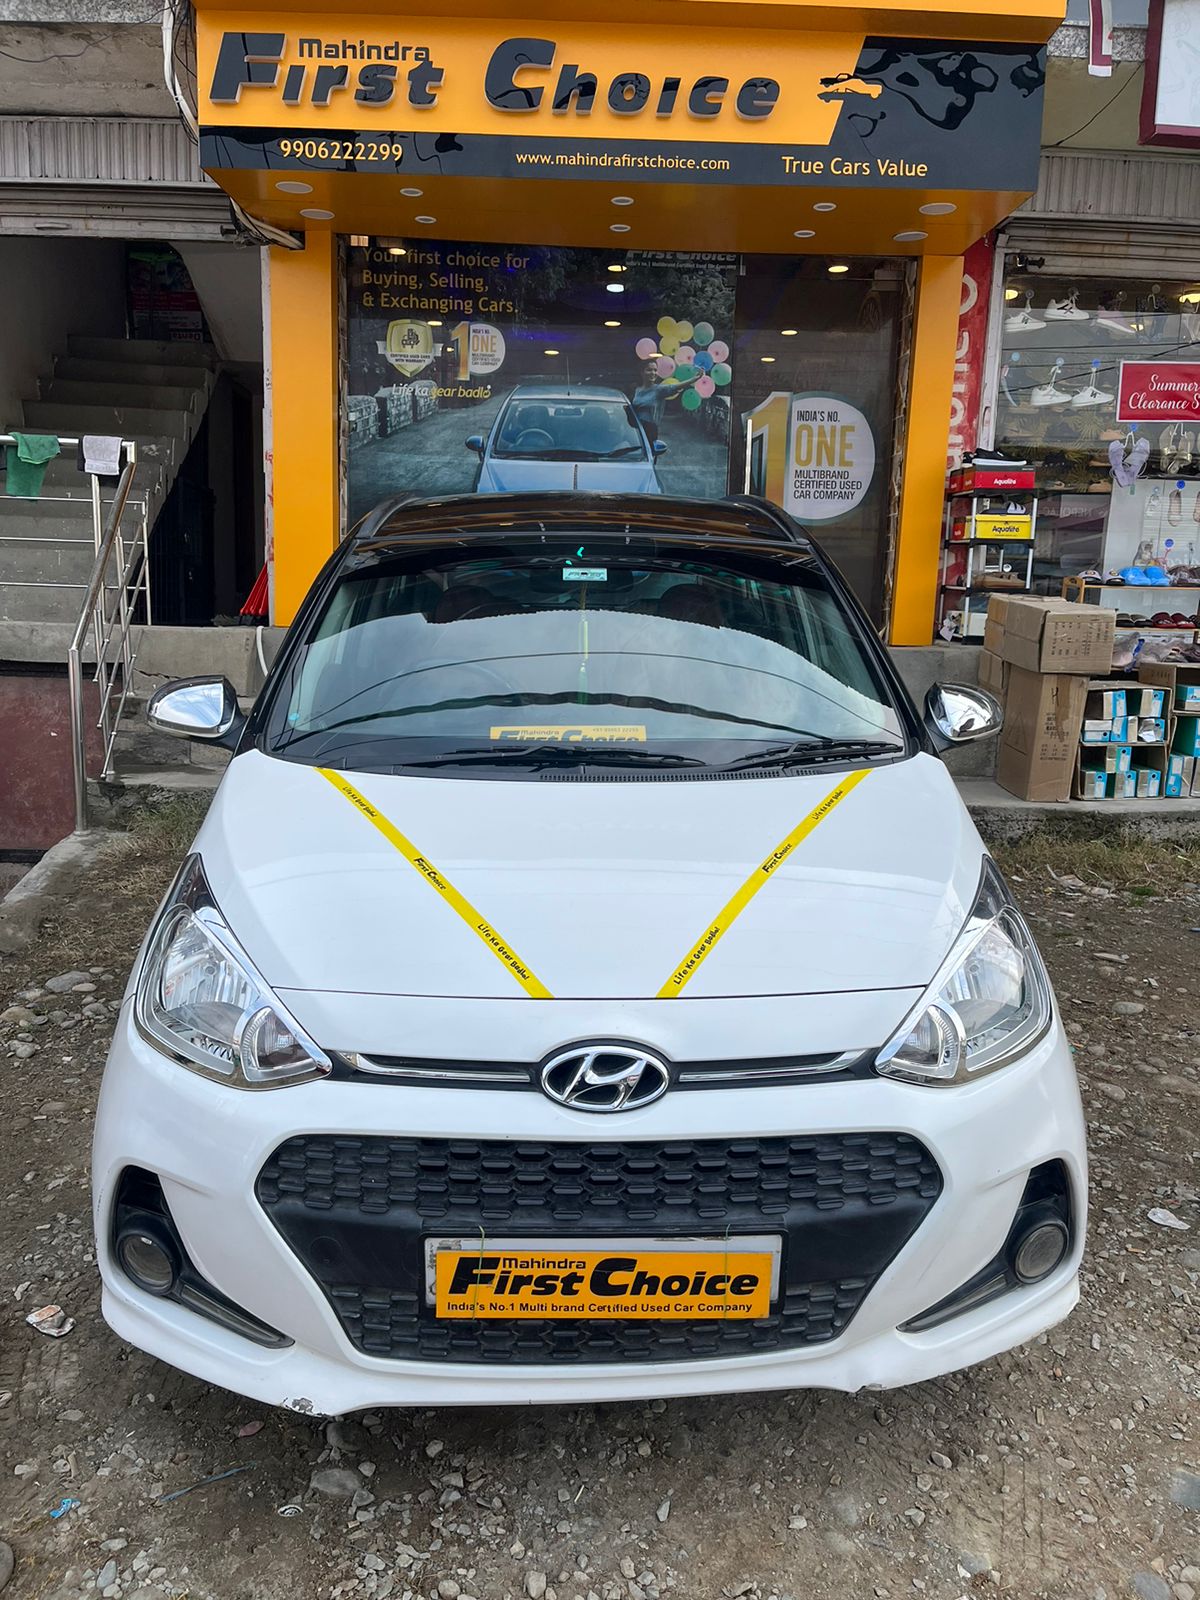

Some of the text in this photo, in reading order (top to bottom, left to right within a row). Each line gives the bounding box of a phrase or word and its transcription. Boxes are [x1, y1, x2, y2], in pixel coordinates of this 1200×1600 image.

[299, 37, 430, 62] Mahindra
[209, 31, 781, 121] First Choice
[280, 139, 403, 161] 9906222299
[516, 152, 730, 170] www.mahindrafirstchoice.com
[781, 156, 928, 177] True Cars Value
[407, 249, 440, 265] first
[447, 251, 500, 267] choice
[505, 253, 530, 269] for
[363, 271, 489, 292] Buying, Selling,
[363, 292, 519, 314] & Exchanging Cars.
[471, 335, 498, 353] ONE
[392, 383, 491, 399] Life ka gear badlo
[1149, 374, 1200, 391] Summer
[1129, 392, 1189, 409] Clearance
[796, 410, 840, 422] INDIA'S NO.
[795, 424, 855, 468] ONE
[794, 470, 849, 480] MULTIBRAND
[794, 480, 862, 490] CERTIFIED USED
[793, 490, 855, 500] CAR COMPANY
[992, 525, 1020, 534] Aqualite
[477, 923, 491, 938] Life
[673, 969, 689, 985] Life
[502, 1257, 586, 1269] Mahindra
[448, 1257, 760, 1297] First Choice
[447, 1302, 752, 1312] India's No.1 Multi brand Certified Used Car Company
